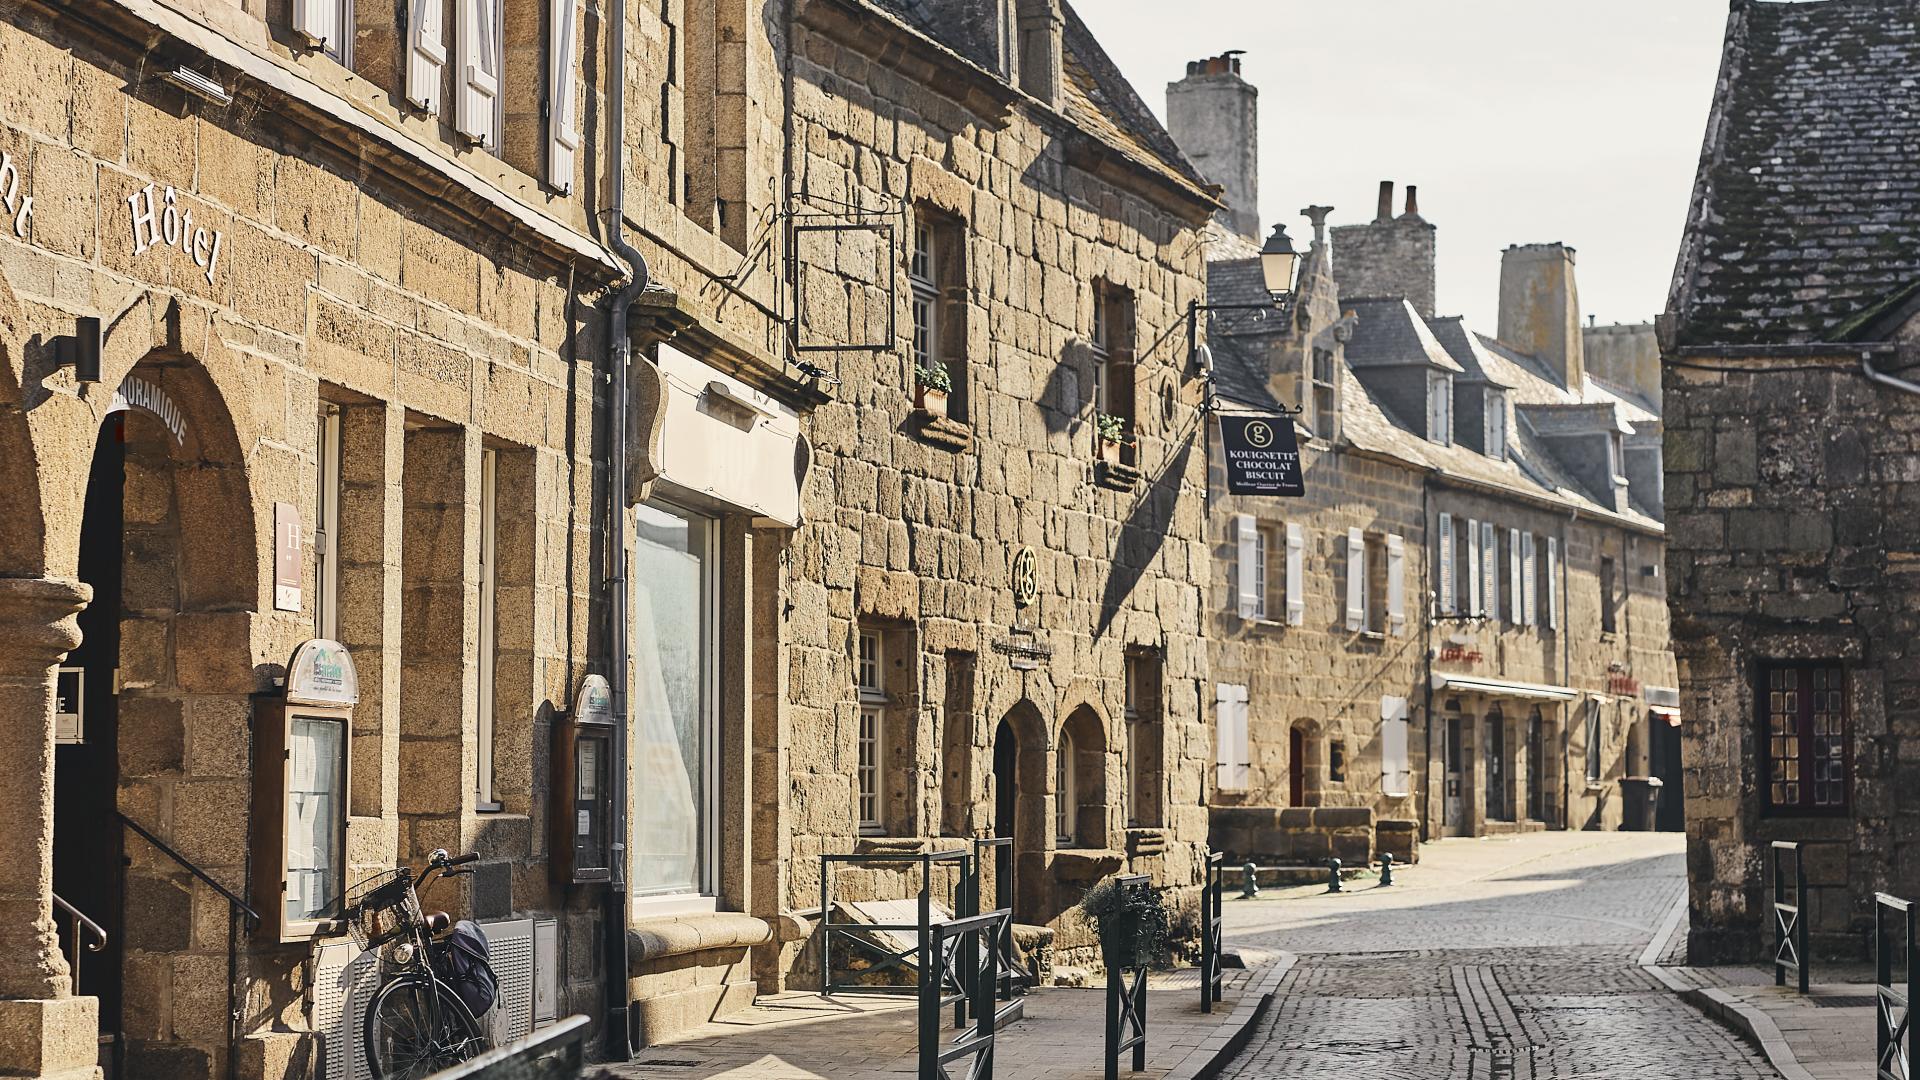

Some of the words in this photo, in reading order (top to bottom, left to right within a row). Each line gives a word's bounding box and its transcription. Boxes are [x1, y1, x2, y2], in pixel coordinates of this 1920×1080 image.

[128, 182, 222, 285] Hôtel
[1253, 425, 1265, 443] g
[1230, 450, 1297, 461] KOUIGNETTE
[1236, 461, 1292, 471] CHOCOLAT
[1246, 471, 1286, 480] BISCUIT
[288, 523, 300, 550] H
